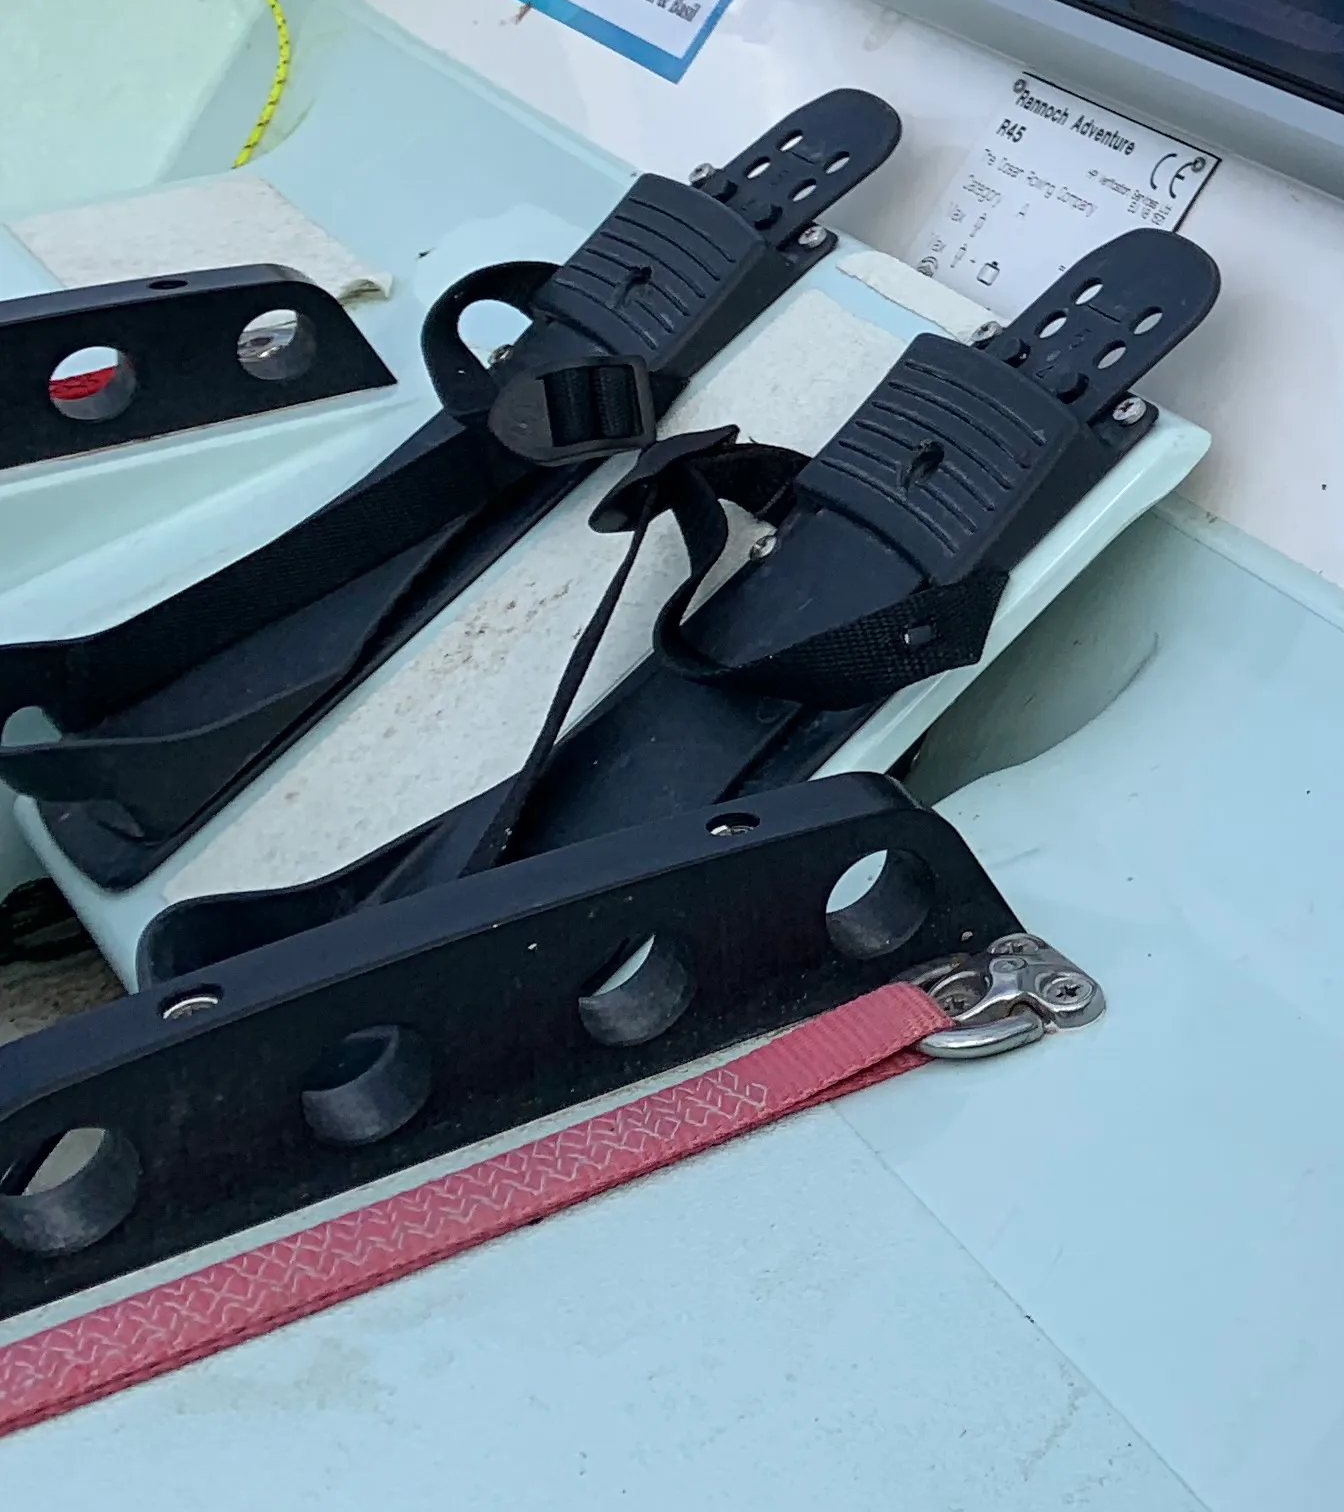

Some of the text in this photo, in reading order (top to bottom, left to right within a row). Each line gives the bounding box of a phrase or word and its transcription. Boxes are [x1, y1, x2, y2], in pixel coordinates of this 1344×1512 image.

[996, 118, 1027, 143] R45
[1015, 88, 1136, 156] Rannoch Adventure
